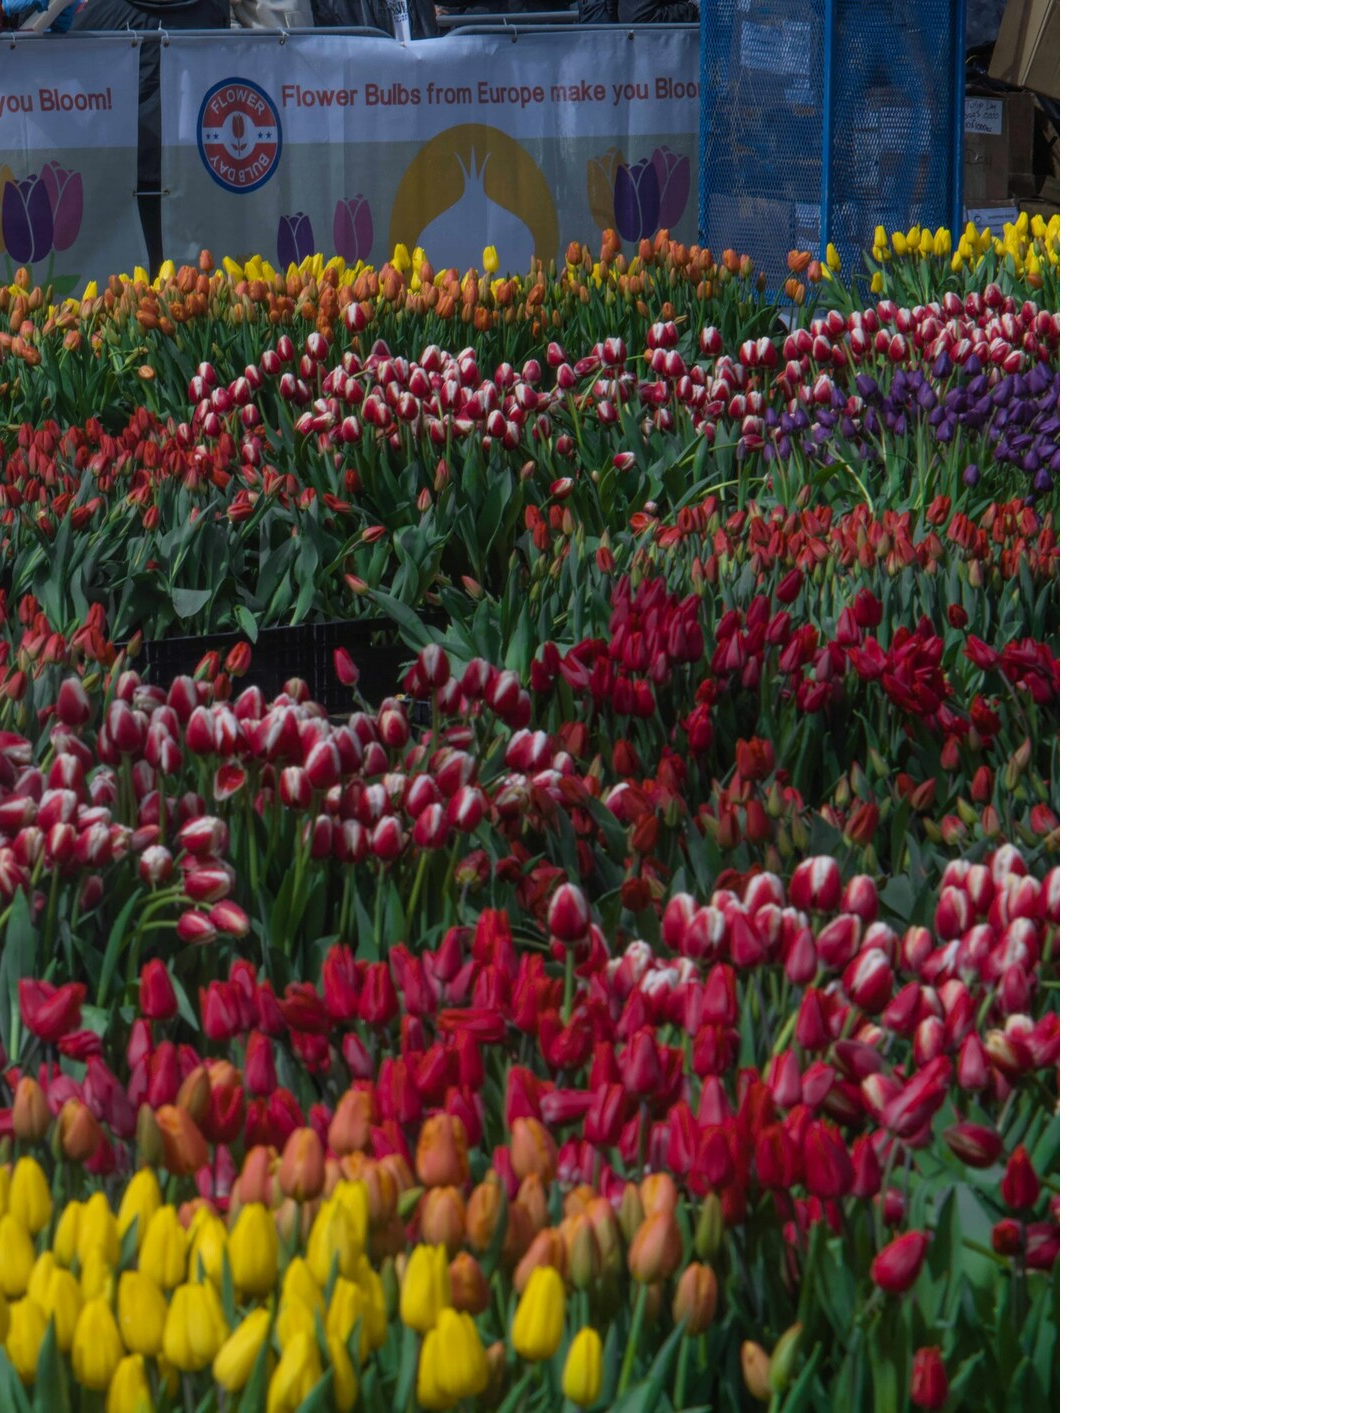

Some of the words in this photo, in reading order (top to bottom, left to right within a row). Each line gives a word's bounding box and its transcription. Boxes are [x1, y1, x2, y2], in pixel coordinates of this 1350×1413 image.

[39, 87, 113, 112] Bloom!
[210, 88, 265, 115] FLOWER
[281, 84, 358, 107] Flower
[364, 83, 422, 106] Bulbs
[426, 82, 472, 105] from
[477, 81, 545, 108] Europe
[551, 80, 606, 103] make
[612, 82, 649, 106] you
[655, 77, 700, 100] Bloo
[210, 155, 236, 182] DAY
[238, 153, 270, 183] BULB
